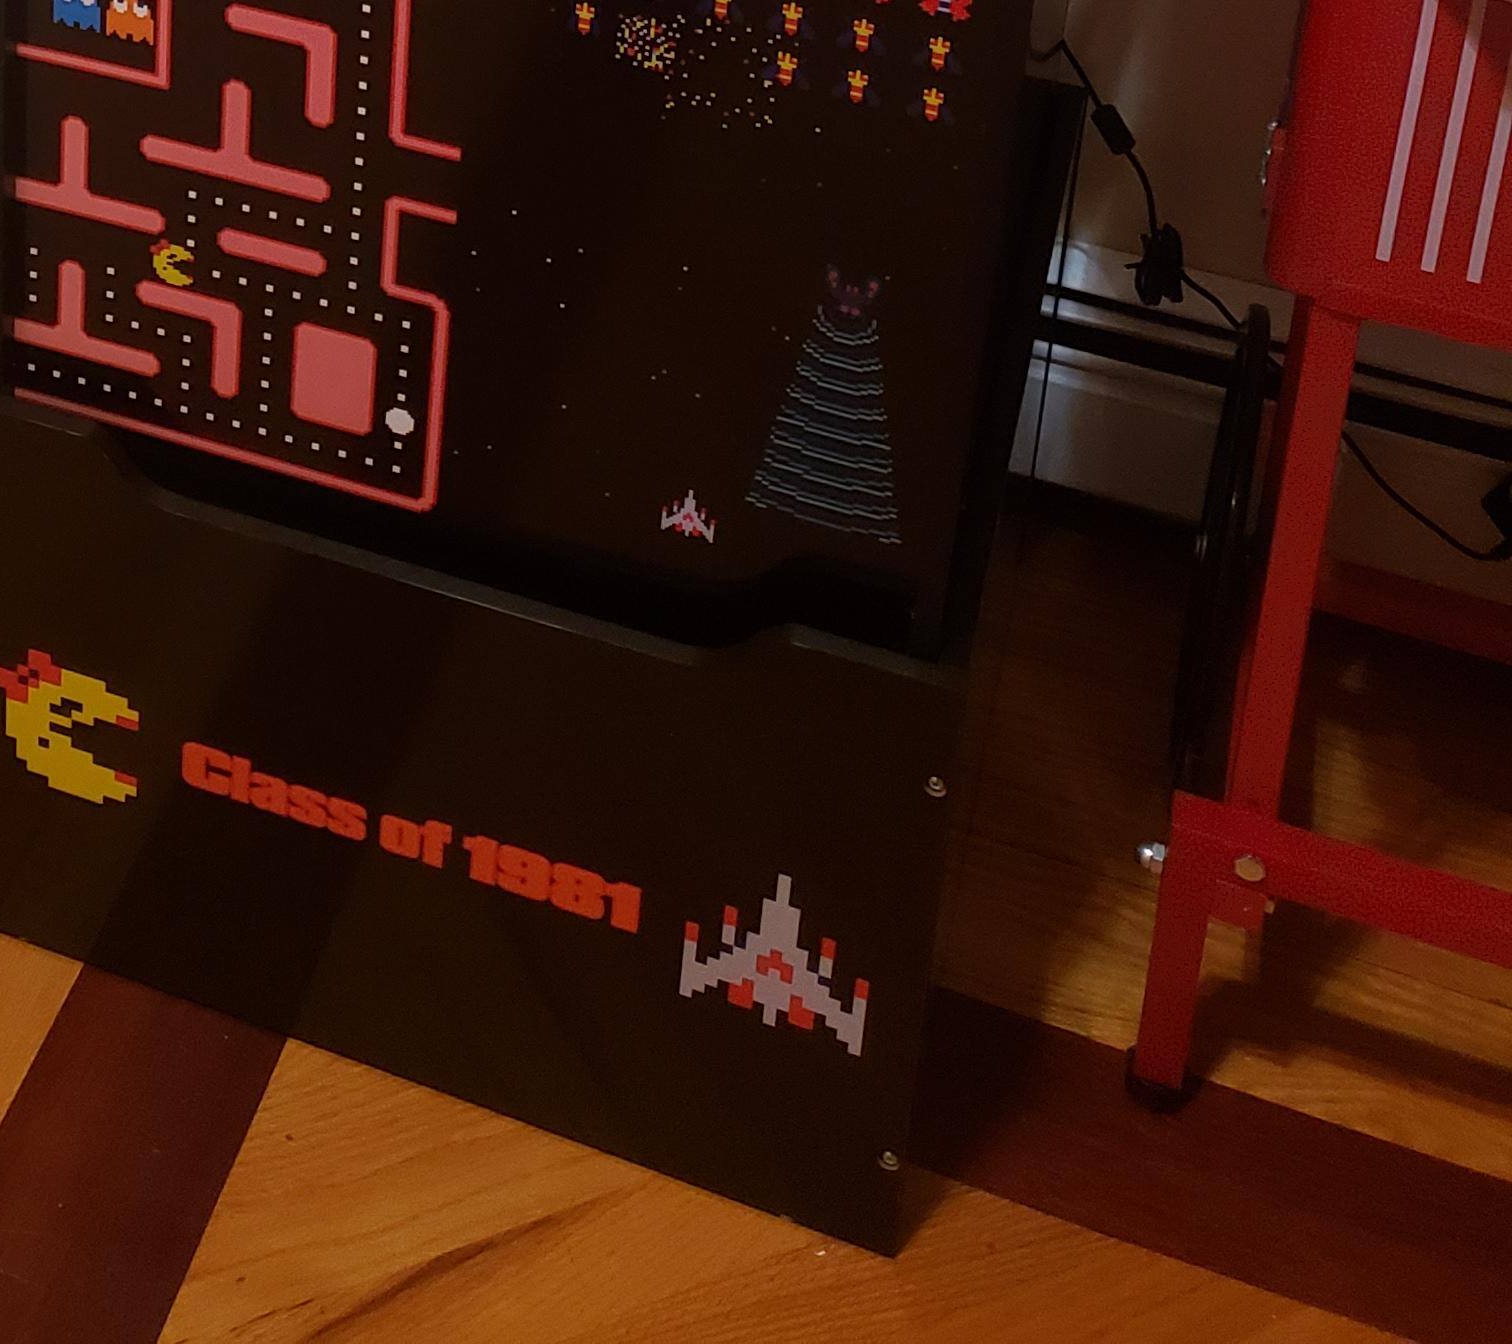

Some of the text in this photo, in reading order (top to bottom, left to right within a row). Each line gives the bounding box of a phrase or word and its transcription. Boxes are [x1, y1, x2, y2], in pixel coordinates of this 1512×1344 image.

[182, 741, 642, 934] Class of 1981
